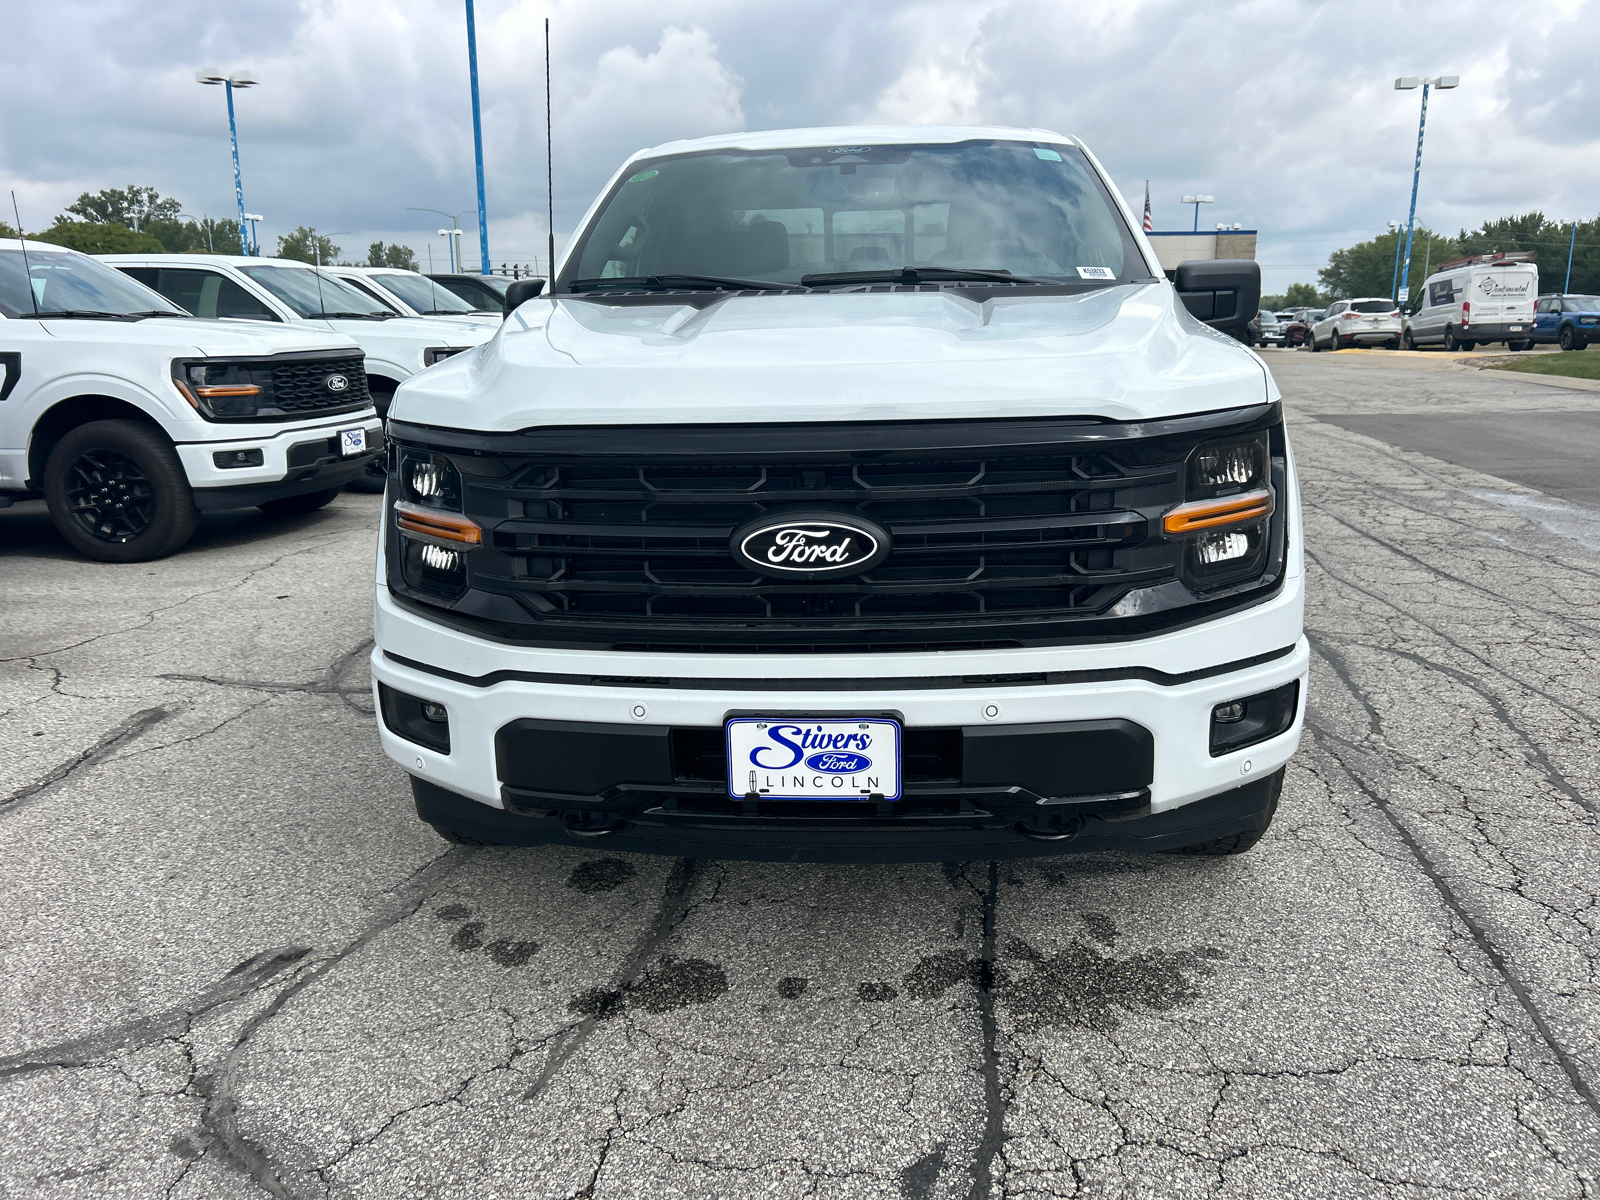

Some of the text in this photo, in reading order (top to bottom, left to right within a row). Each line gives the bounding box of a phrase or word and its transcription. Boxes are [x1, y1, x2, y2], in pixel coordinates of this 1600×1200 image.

[332, 378, 345, 388] Ford
[767, 529, 851, 563] Ford
[749, 724, 873, 770] Stivers
[818, 753, 858, 770] Ford
[766, 775, 879, 788] LINCOLN
